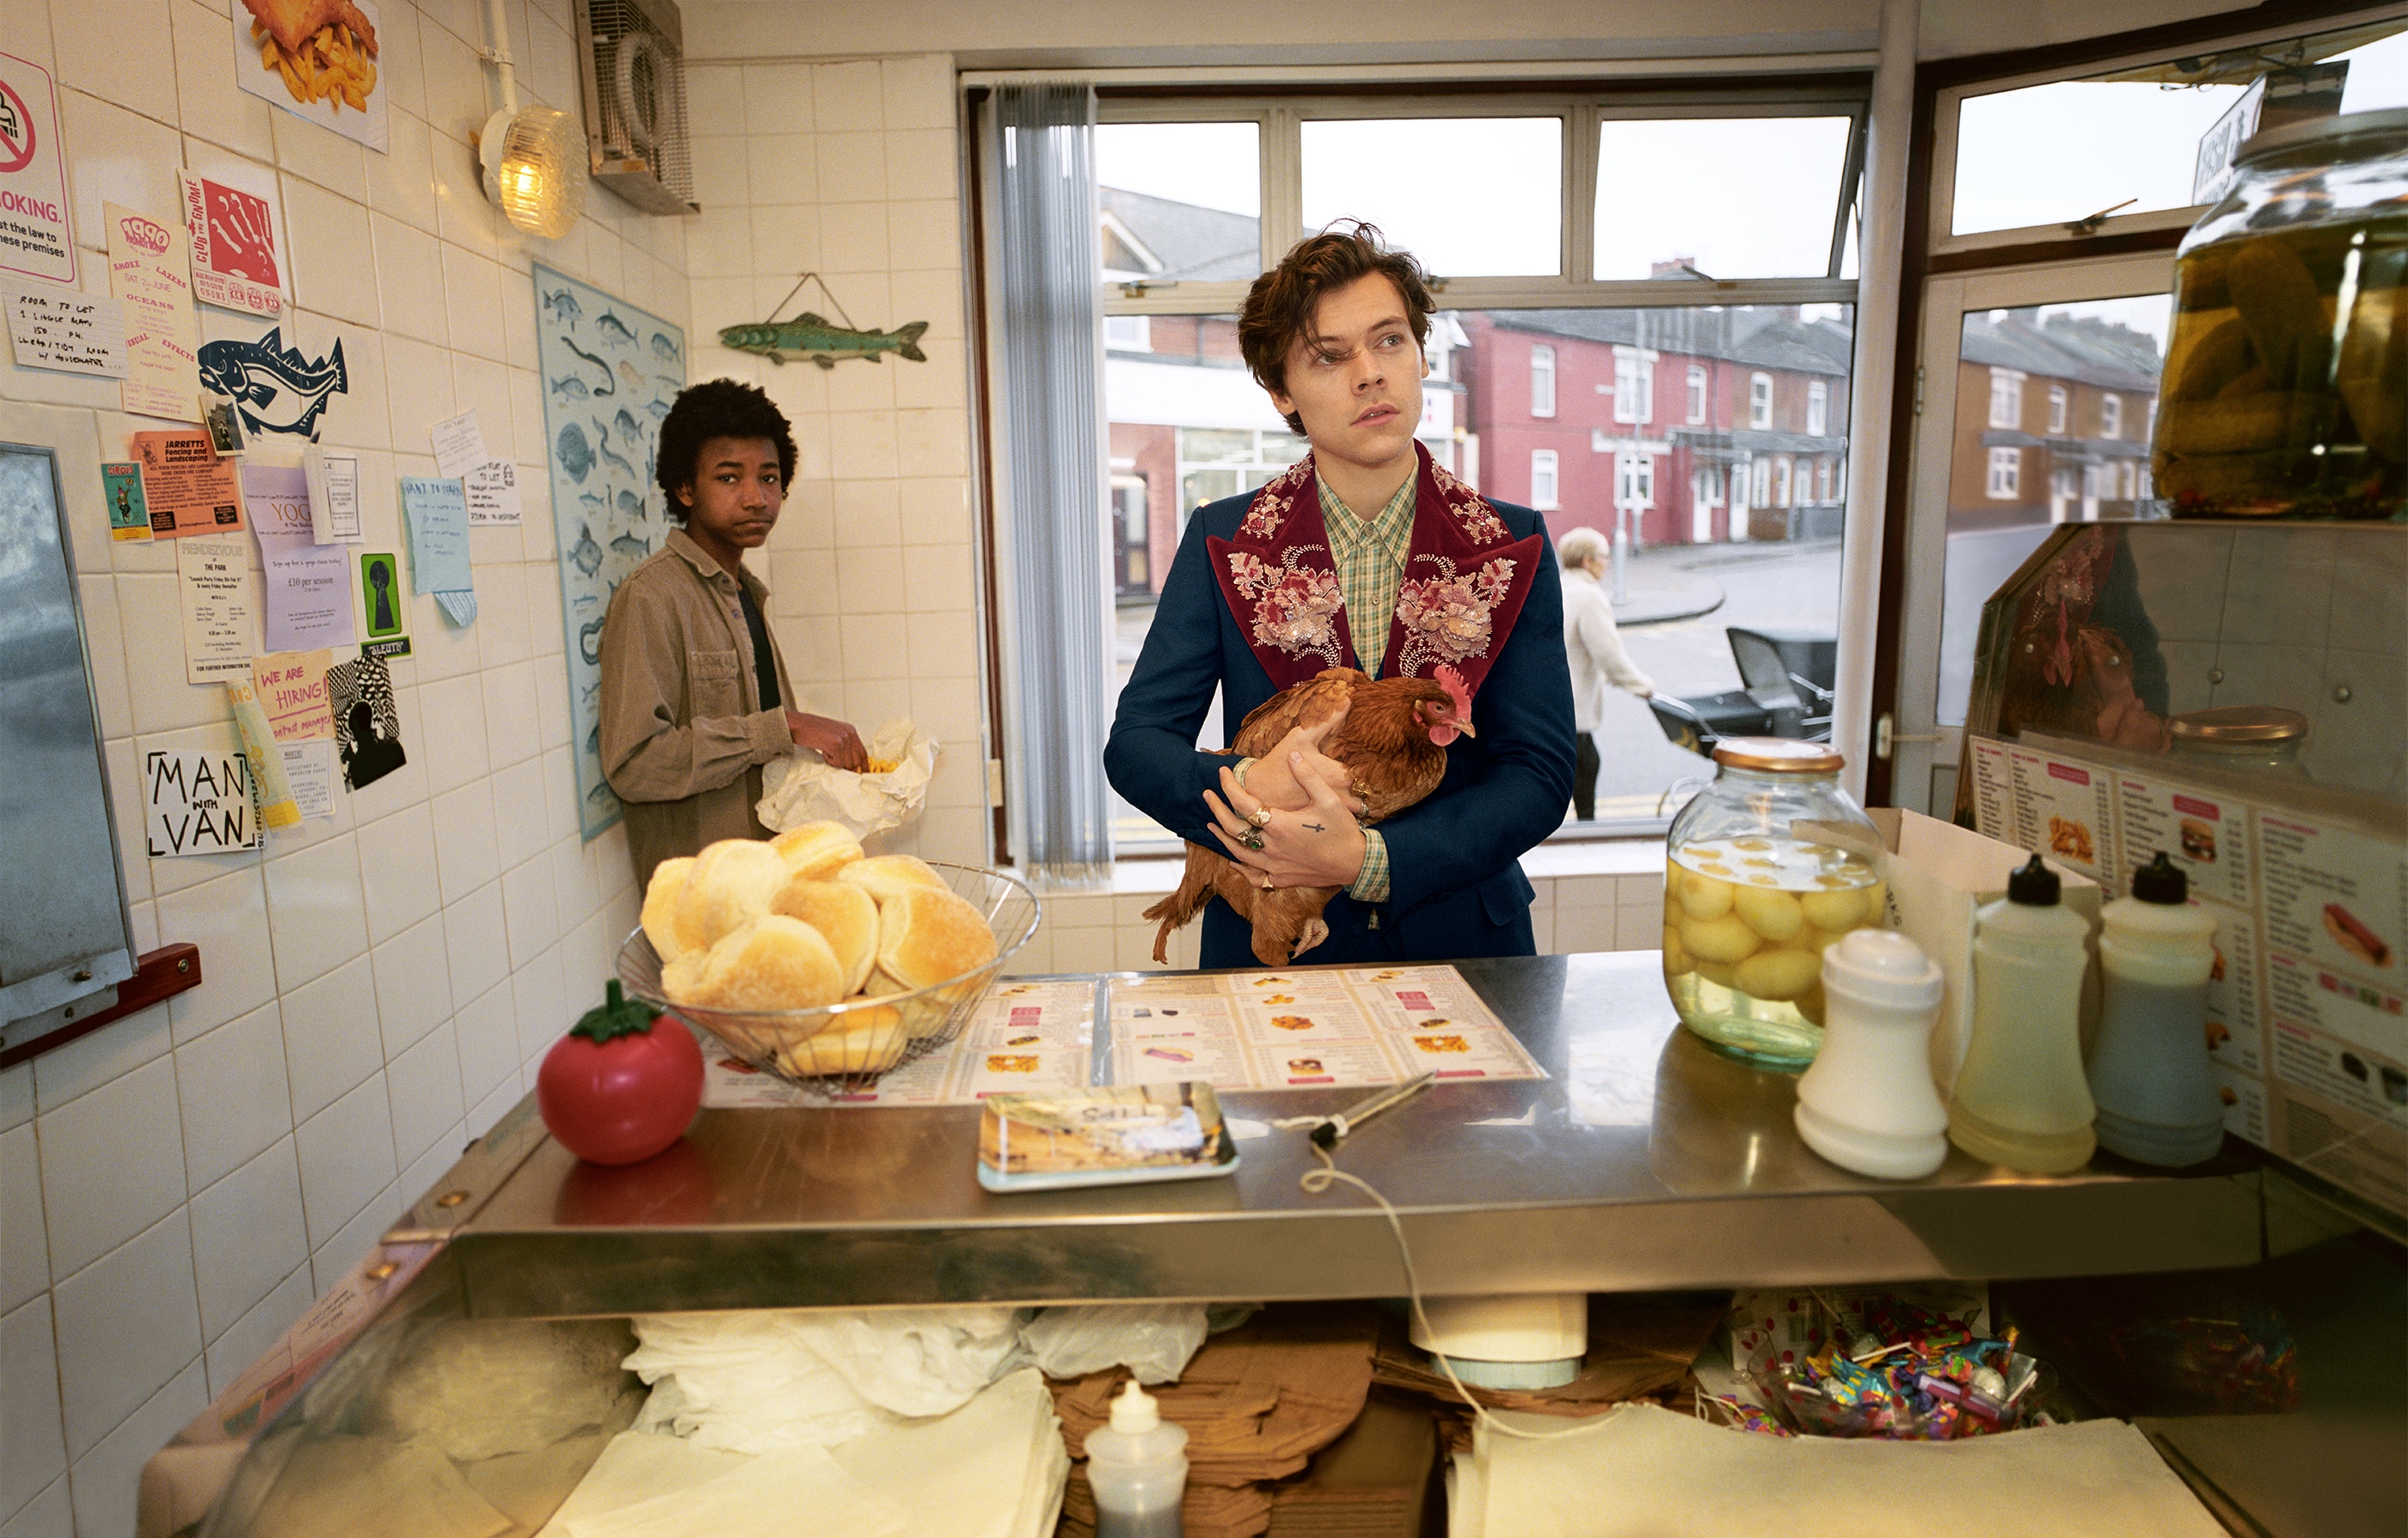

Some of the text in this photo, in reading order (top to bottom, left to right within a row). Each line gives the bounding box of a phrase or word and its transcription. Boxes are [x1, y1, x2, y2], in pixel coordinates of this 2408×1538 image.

[0, 191, 62, 224] OKING.
[186, 178, 204, 220] GNOME
[9, 222, 27, 235] the
[28, 225, 45, 239] law
[46, 232, 57, 243] to
[22, 240, 64, 257] premises
[194, 236, 207, 263] CLUB
[114, 260, 140, 271] SMOKE
[156, 266, 187, 289] LAZERS
[153, 281, 171, 292] JUNE
[20, 296, 47, 307] ROOM
[77, 305, 95, 314] LET
[126, 293, 175, 311] OCEANS
[71, 317, 92, 327] MAN
[86, 347, 109, 356] ROOM
[162, 339, 195, 362] EFFECTS
[165, 440, 205, 449] JARRETTS
[165, 454, 208, 464] Landscaping
[108, 466, 134, 476] CIRCUS
[272, 503, 311, 522] YOG
[182, 543, 243, 557] RENDEZVOUS
[289, 576, 334, 588] £10 per session
[261, 666, 304, 688] WE ARE
[275, 675, 329, 710] HIRING!
[273, 714, 333, 738] ontact manager
[153, 756, 243, 804] MAN
[193, 799, 218, 810] WITH
[162, 805, 244, 854] VAN
